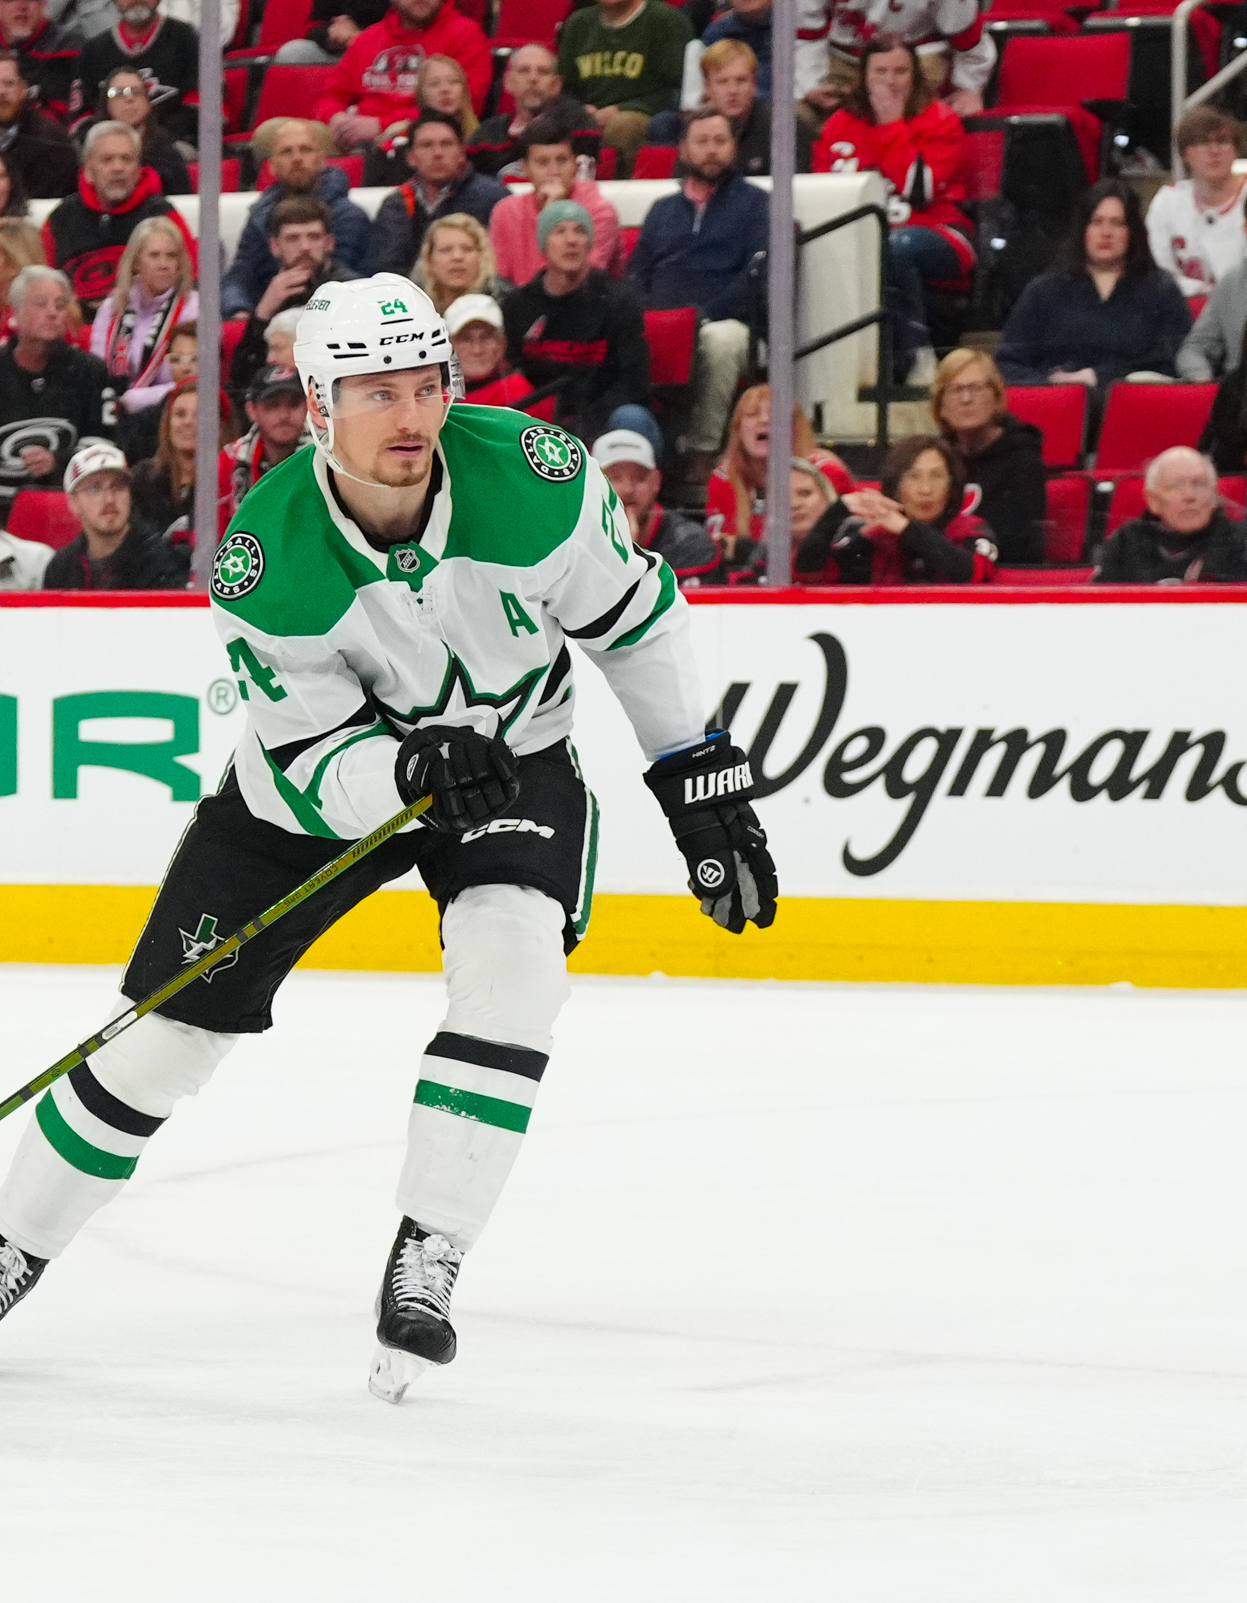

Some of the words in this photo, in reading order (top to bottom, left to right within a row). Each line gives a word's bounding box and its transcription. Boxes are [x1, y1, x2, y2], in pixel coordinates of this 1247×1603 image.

[377, 298, 409, 316] 24
[379, 331, 425, 346] CCM
[498, 589, 539, 638] A
[460, 818, 556, 844] CCM
[303, 863, 339, 893] COVERT
